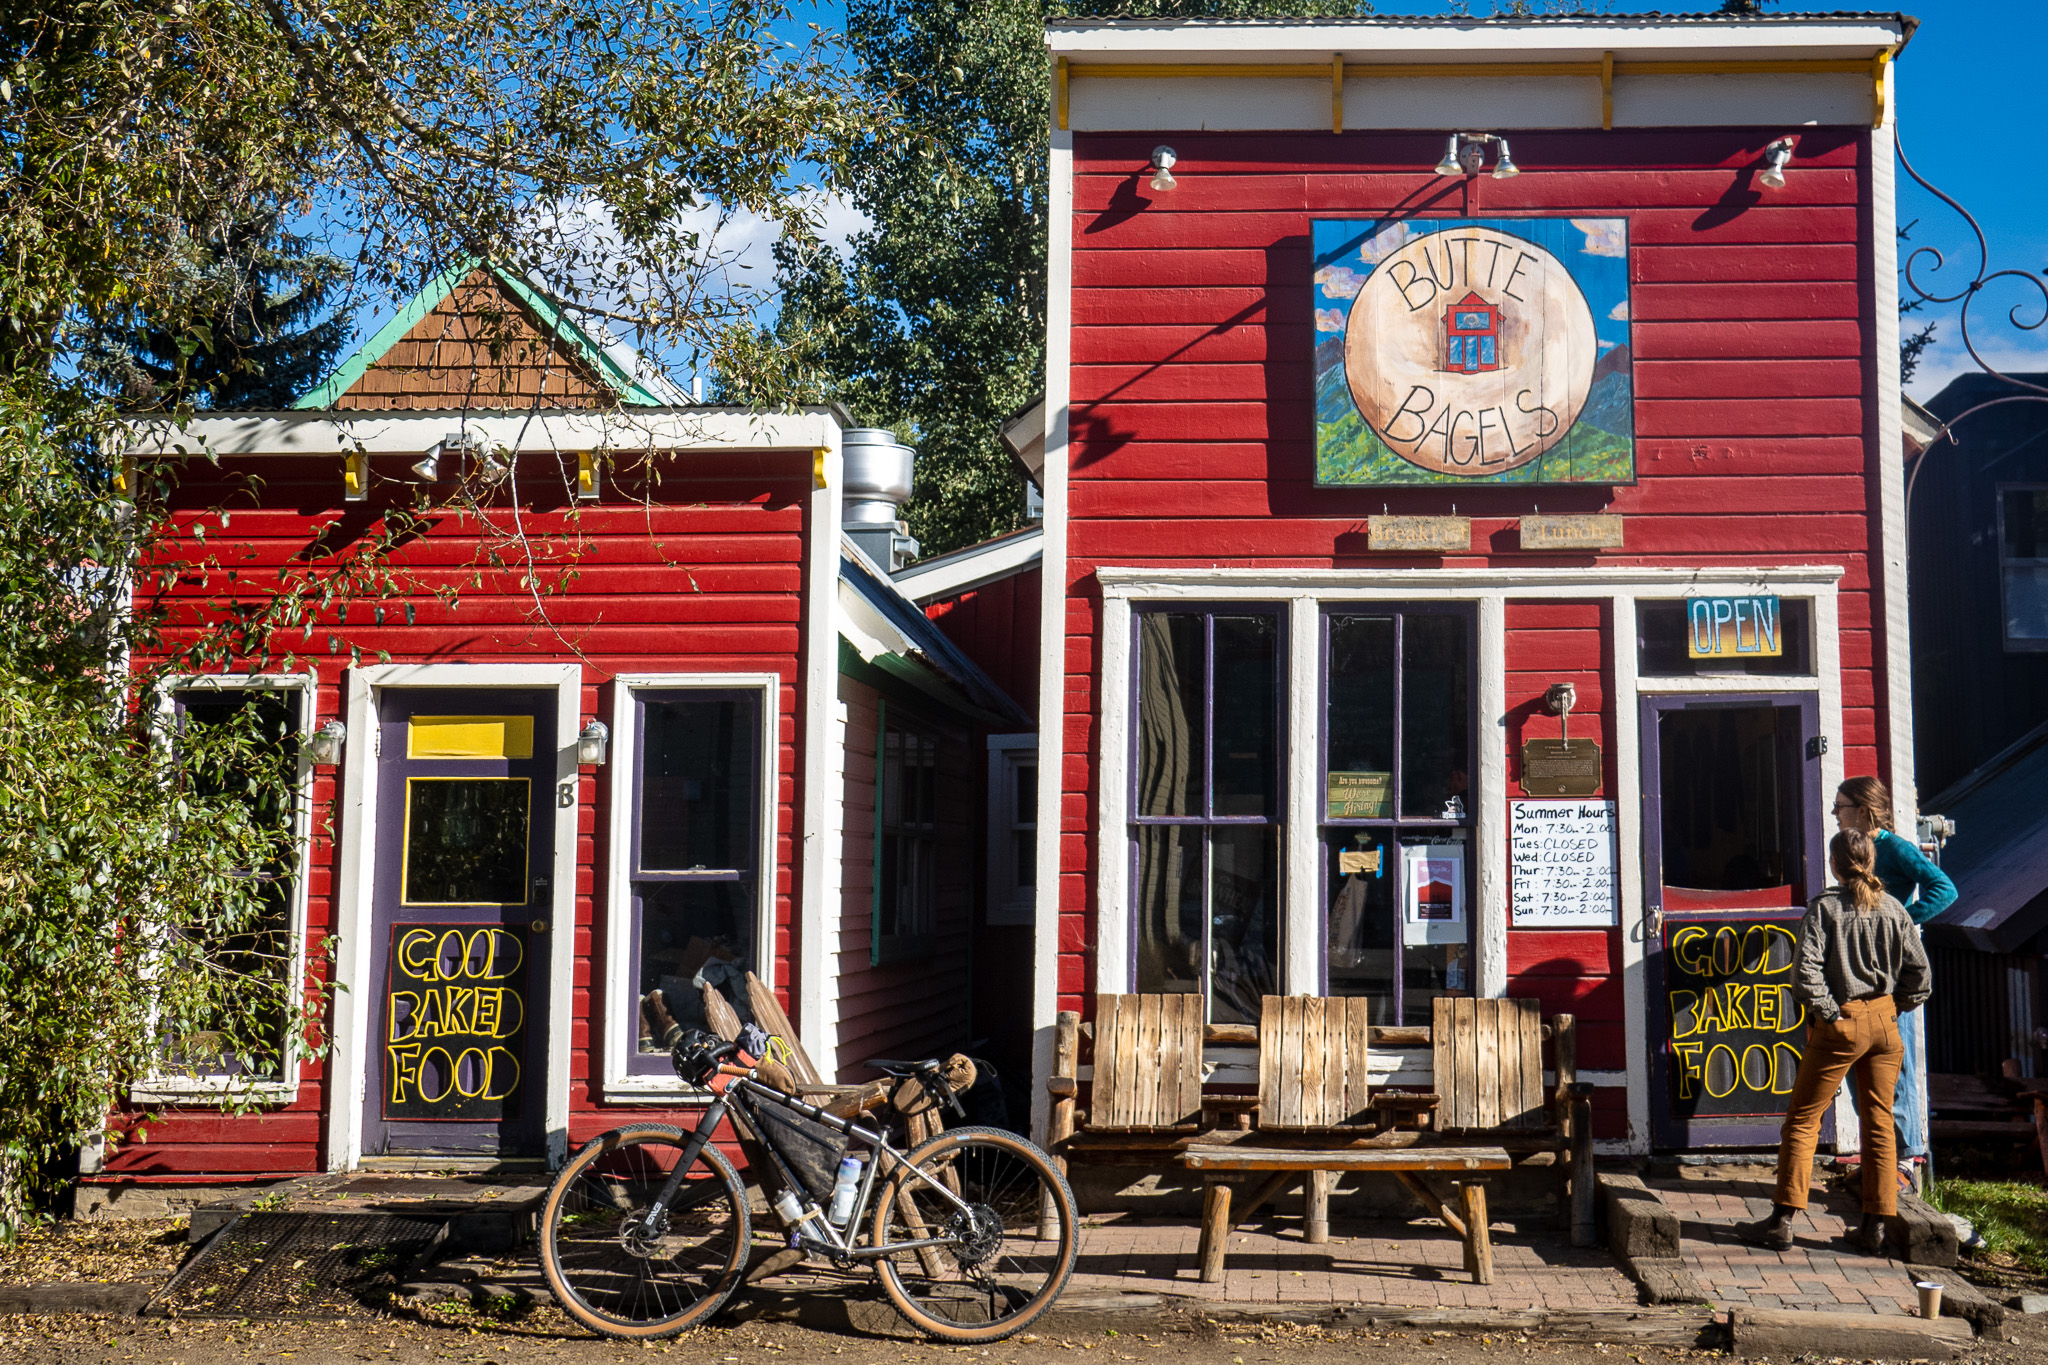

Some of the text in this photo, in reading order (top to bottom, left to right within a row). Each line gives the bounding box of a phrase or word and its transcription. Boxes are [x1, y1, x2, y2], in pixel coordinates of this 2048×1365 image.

[1385, 238, 1538, 311] BUTTE
[1380, 385, 1558, 466] BAGELS
[1372, 521, 1468, 543] Breakfast
[1540, 521, 1604, 542] Lunch
[1693, 598, 1776, 654] OPEN
[1349, 778, 1358, 786] you
[558, 783, 575, 808] B
[1344, 797, 1379, 815] Hiring!
[1514, 803, 1615, 819] Summer Hours
[1513, 823, 1542, 834] Mon:
[1512, 837, 1598, 850] Tues: CLOSED
[1513, 851, 1595, 863] Wed: CLOSED
[1512, 864, 1544, 876] Thur:
[398, 928, 523, 981] GOOD
[1673, 925, 1797, 976] GOOD
[389, 985, 523, 1042] BAKED
[1670, 983, 1805, 1039] BAKED
[387, 1043, 520, 1103] FOOD
[1672, 1041, 1802, 1099] FOOD
